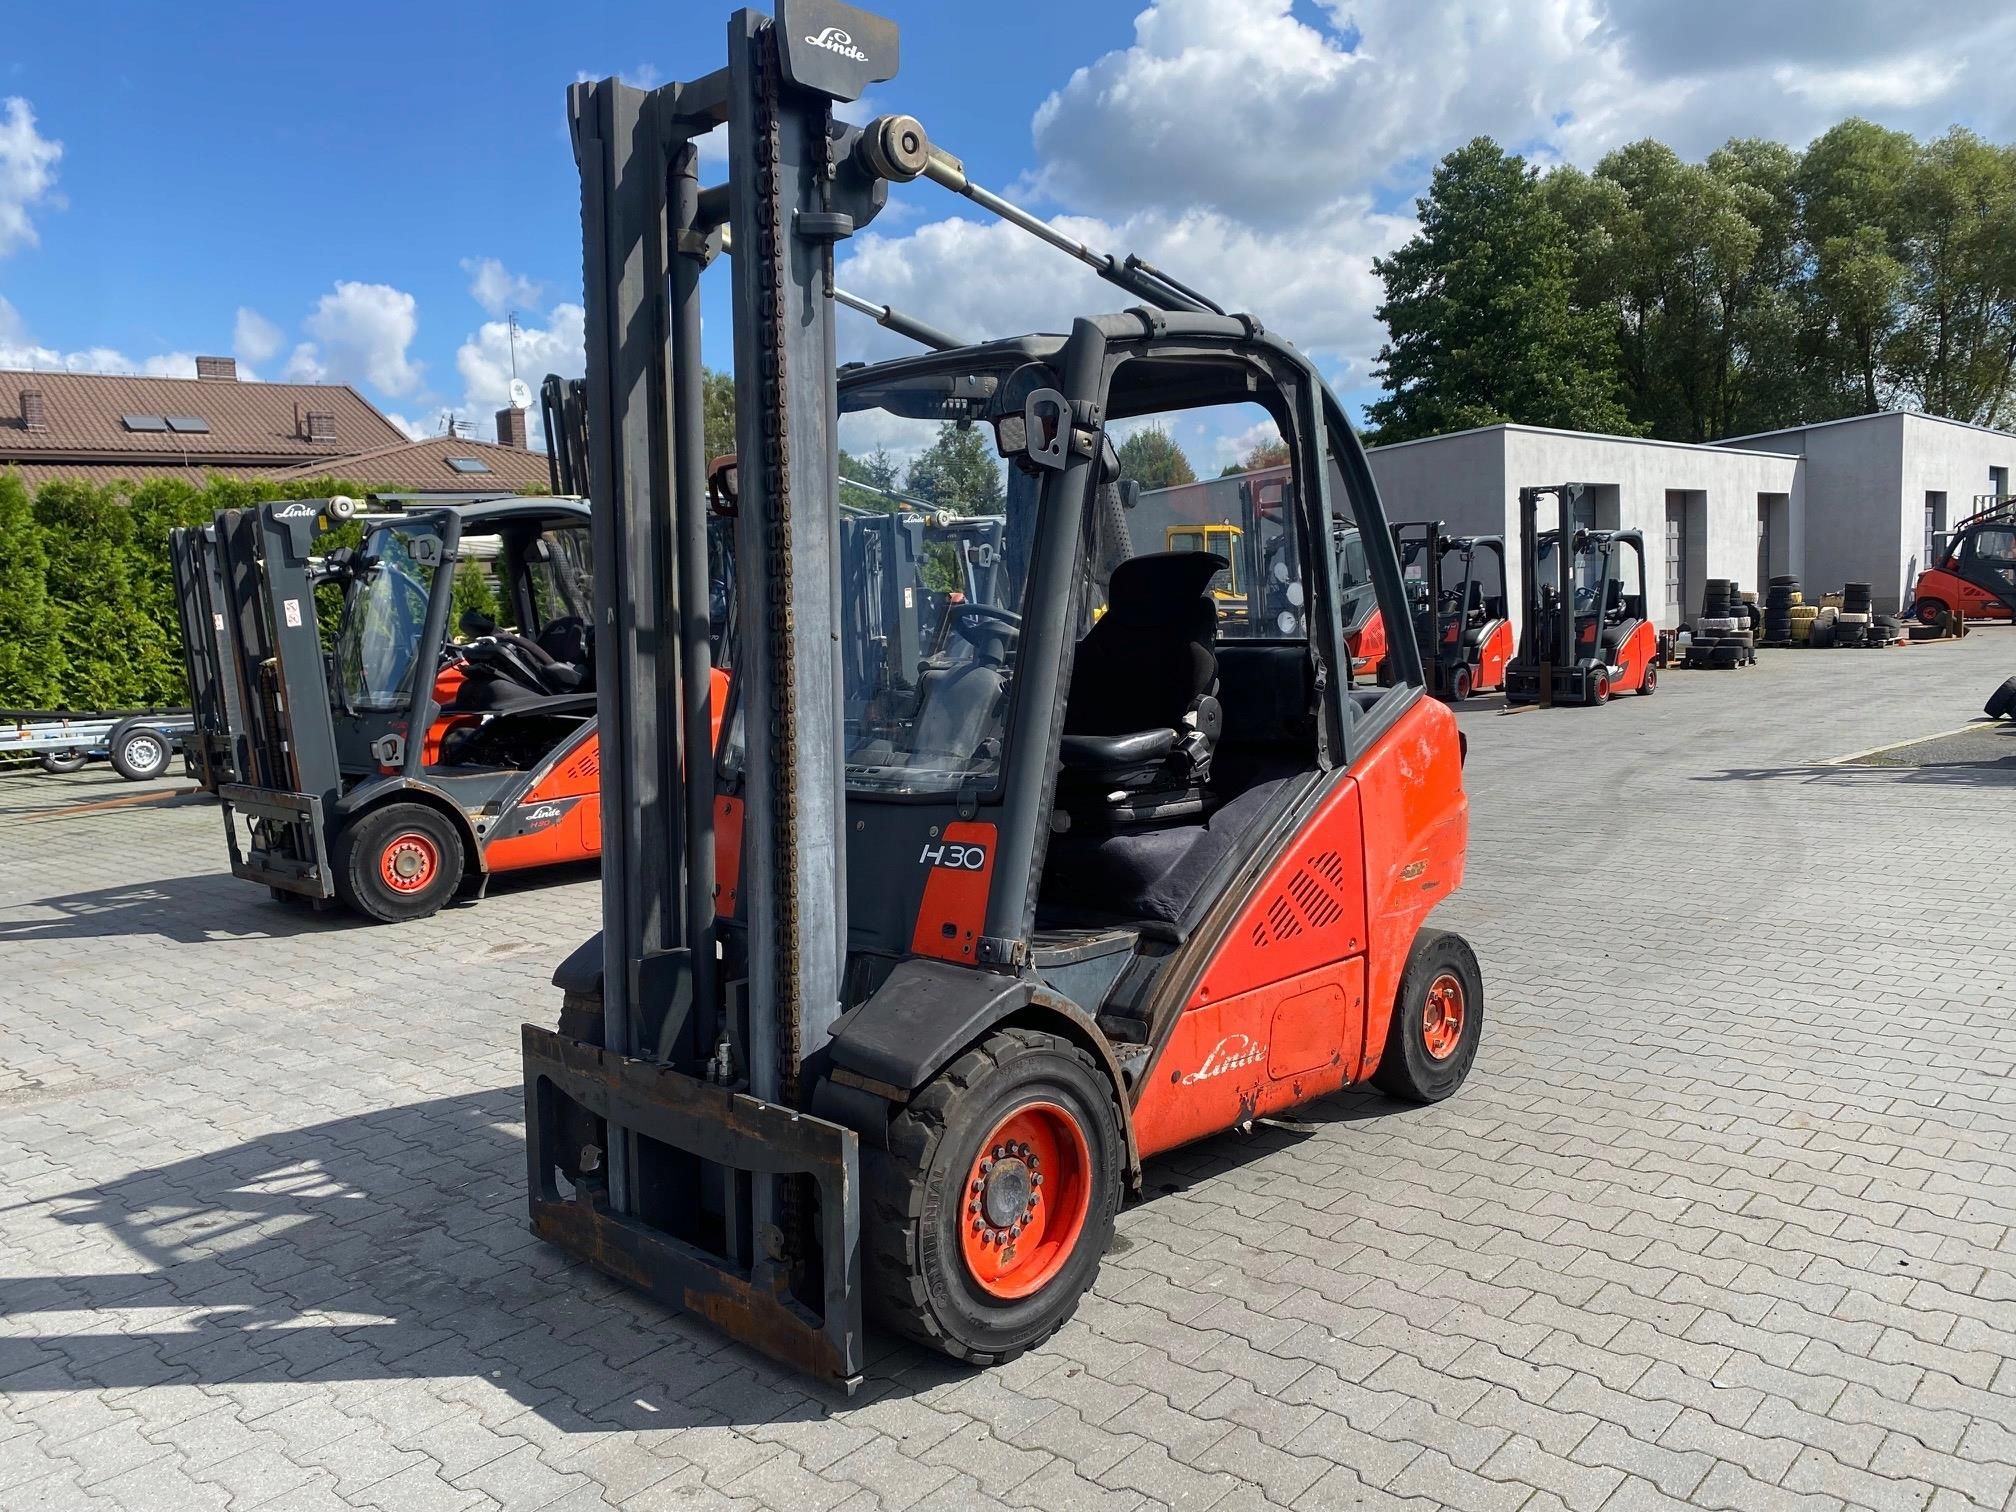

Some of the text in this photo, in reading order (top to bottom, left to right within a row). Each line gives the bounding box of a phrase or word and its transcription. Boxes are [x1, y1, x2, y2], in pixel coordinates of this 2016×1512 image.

[805, 27, 868, 61] Linde
[274, 503, 317, 518] Linde
[903, 513, 925, 523] Linde
[526, 806, 560, 820] Linde
[919, 844, 985, 869] H30
[1182, 1034, 1267, 1086] Linde
